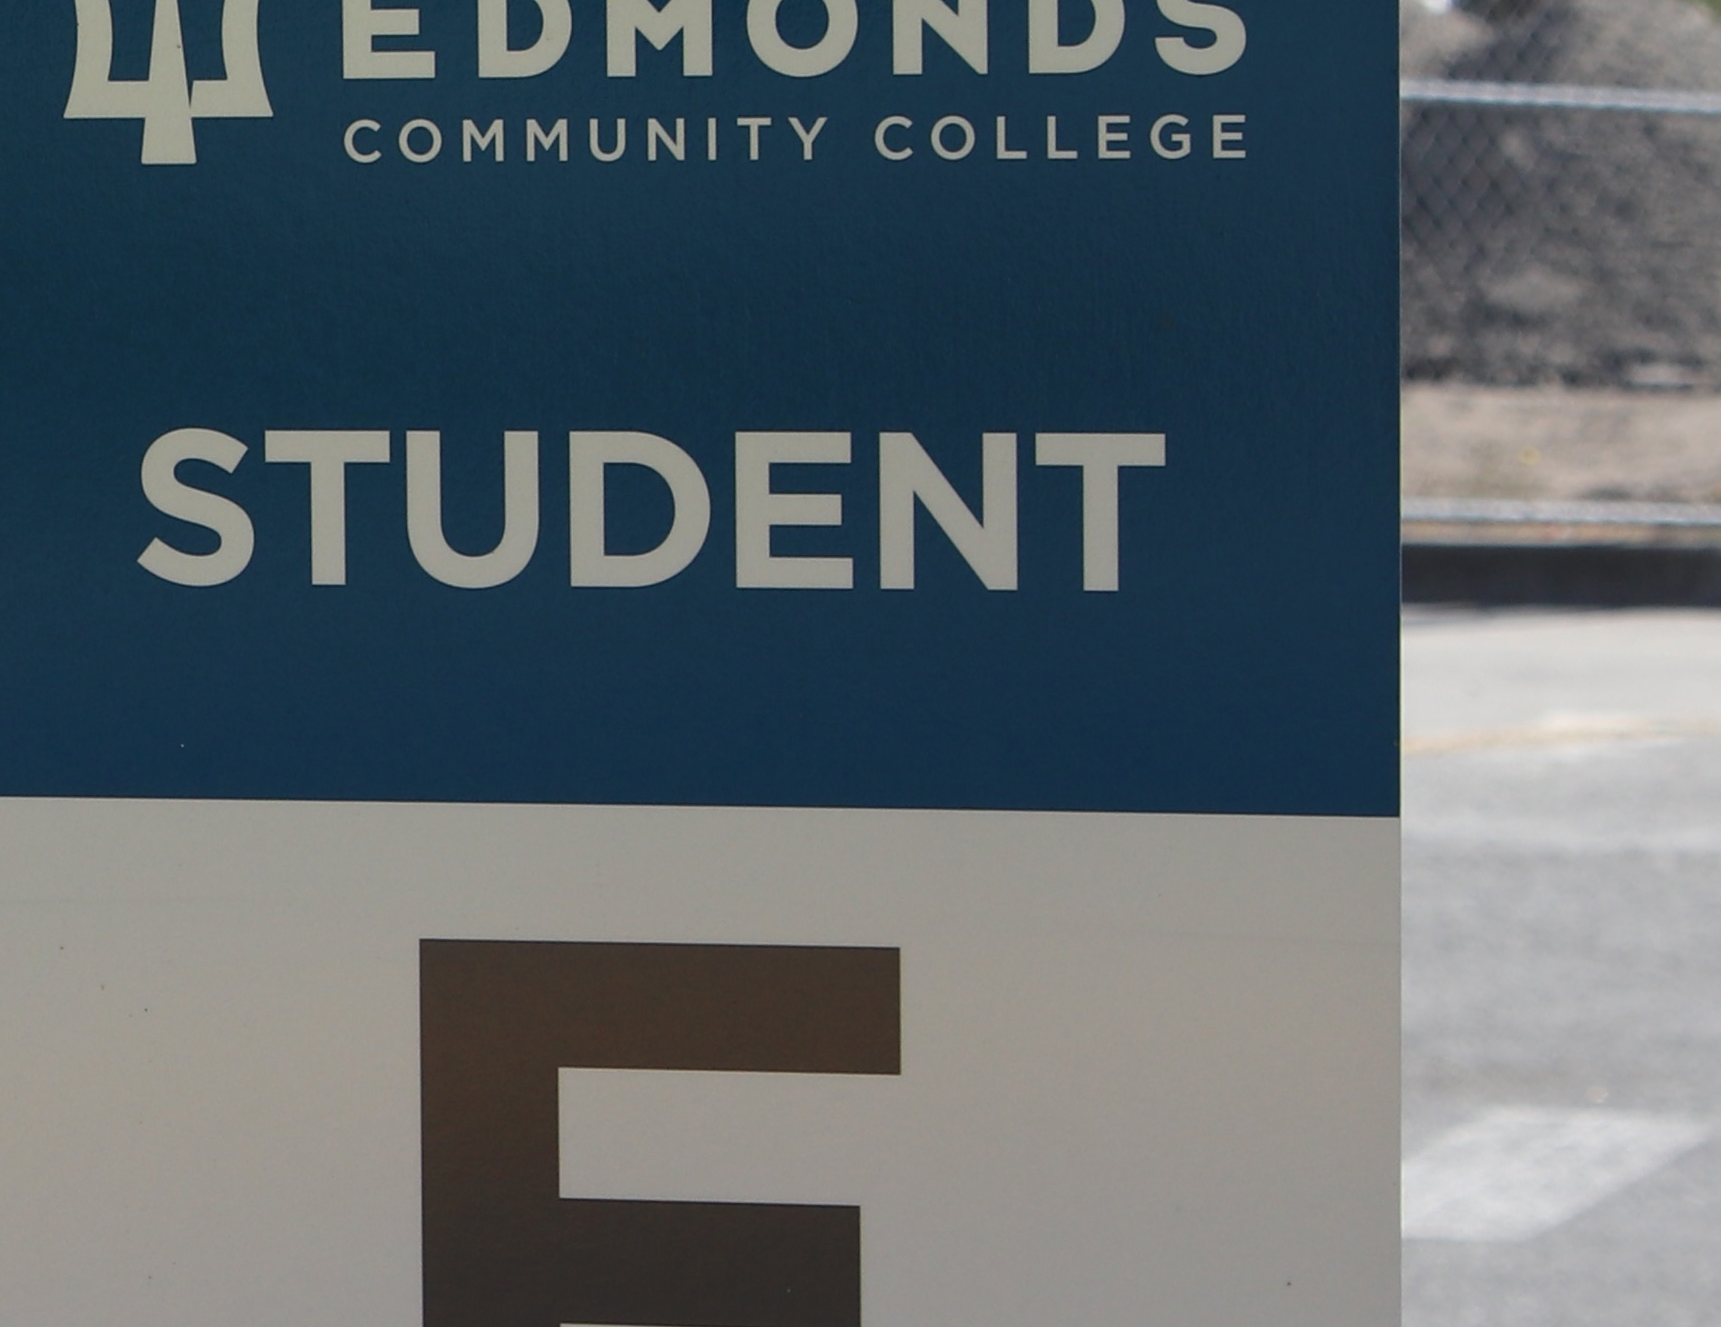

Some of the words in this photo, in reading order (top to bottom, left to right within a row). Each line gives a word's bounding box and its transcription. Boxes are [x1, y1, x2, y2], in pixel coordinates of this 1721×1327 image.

[344, 117, 827, 163] COMMUNITY
[875, 114, 1247, 161] COLLEGE
[138, 428, 1165, 591] STUDENT
